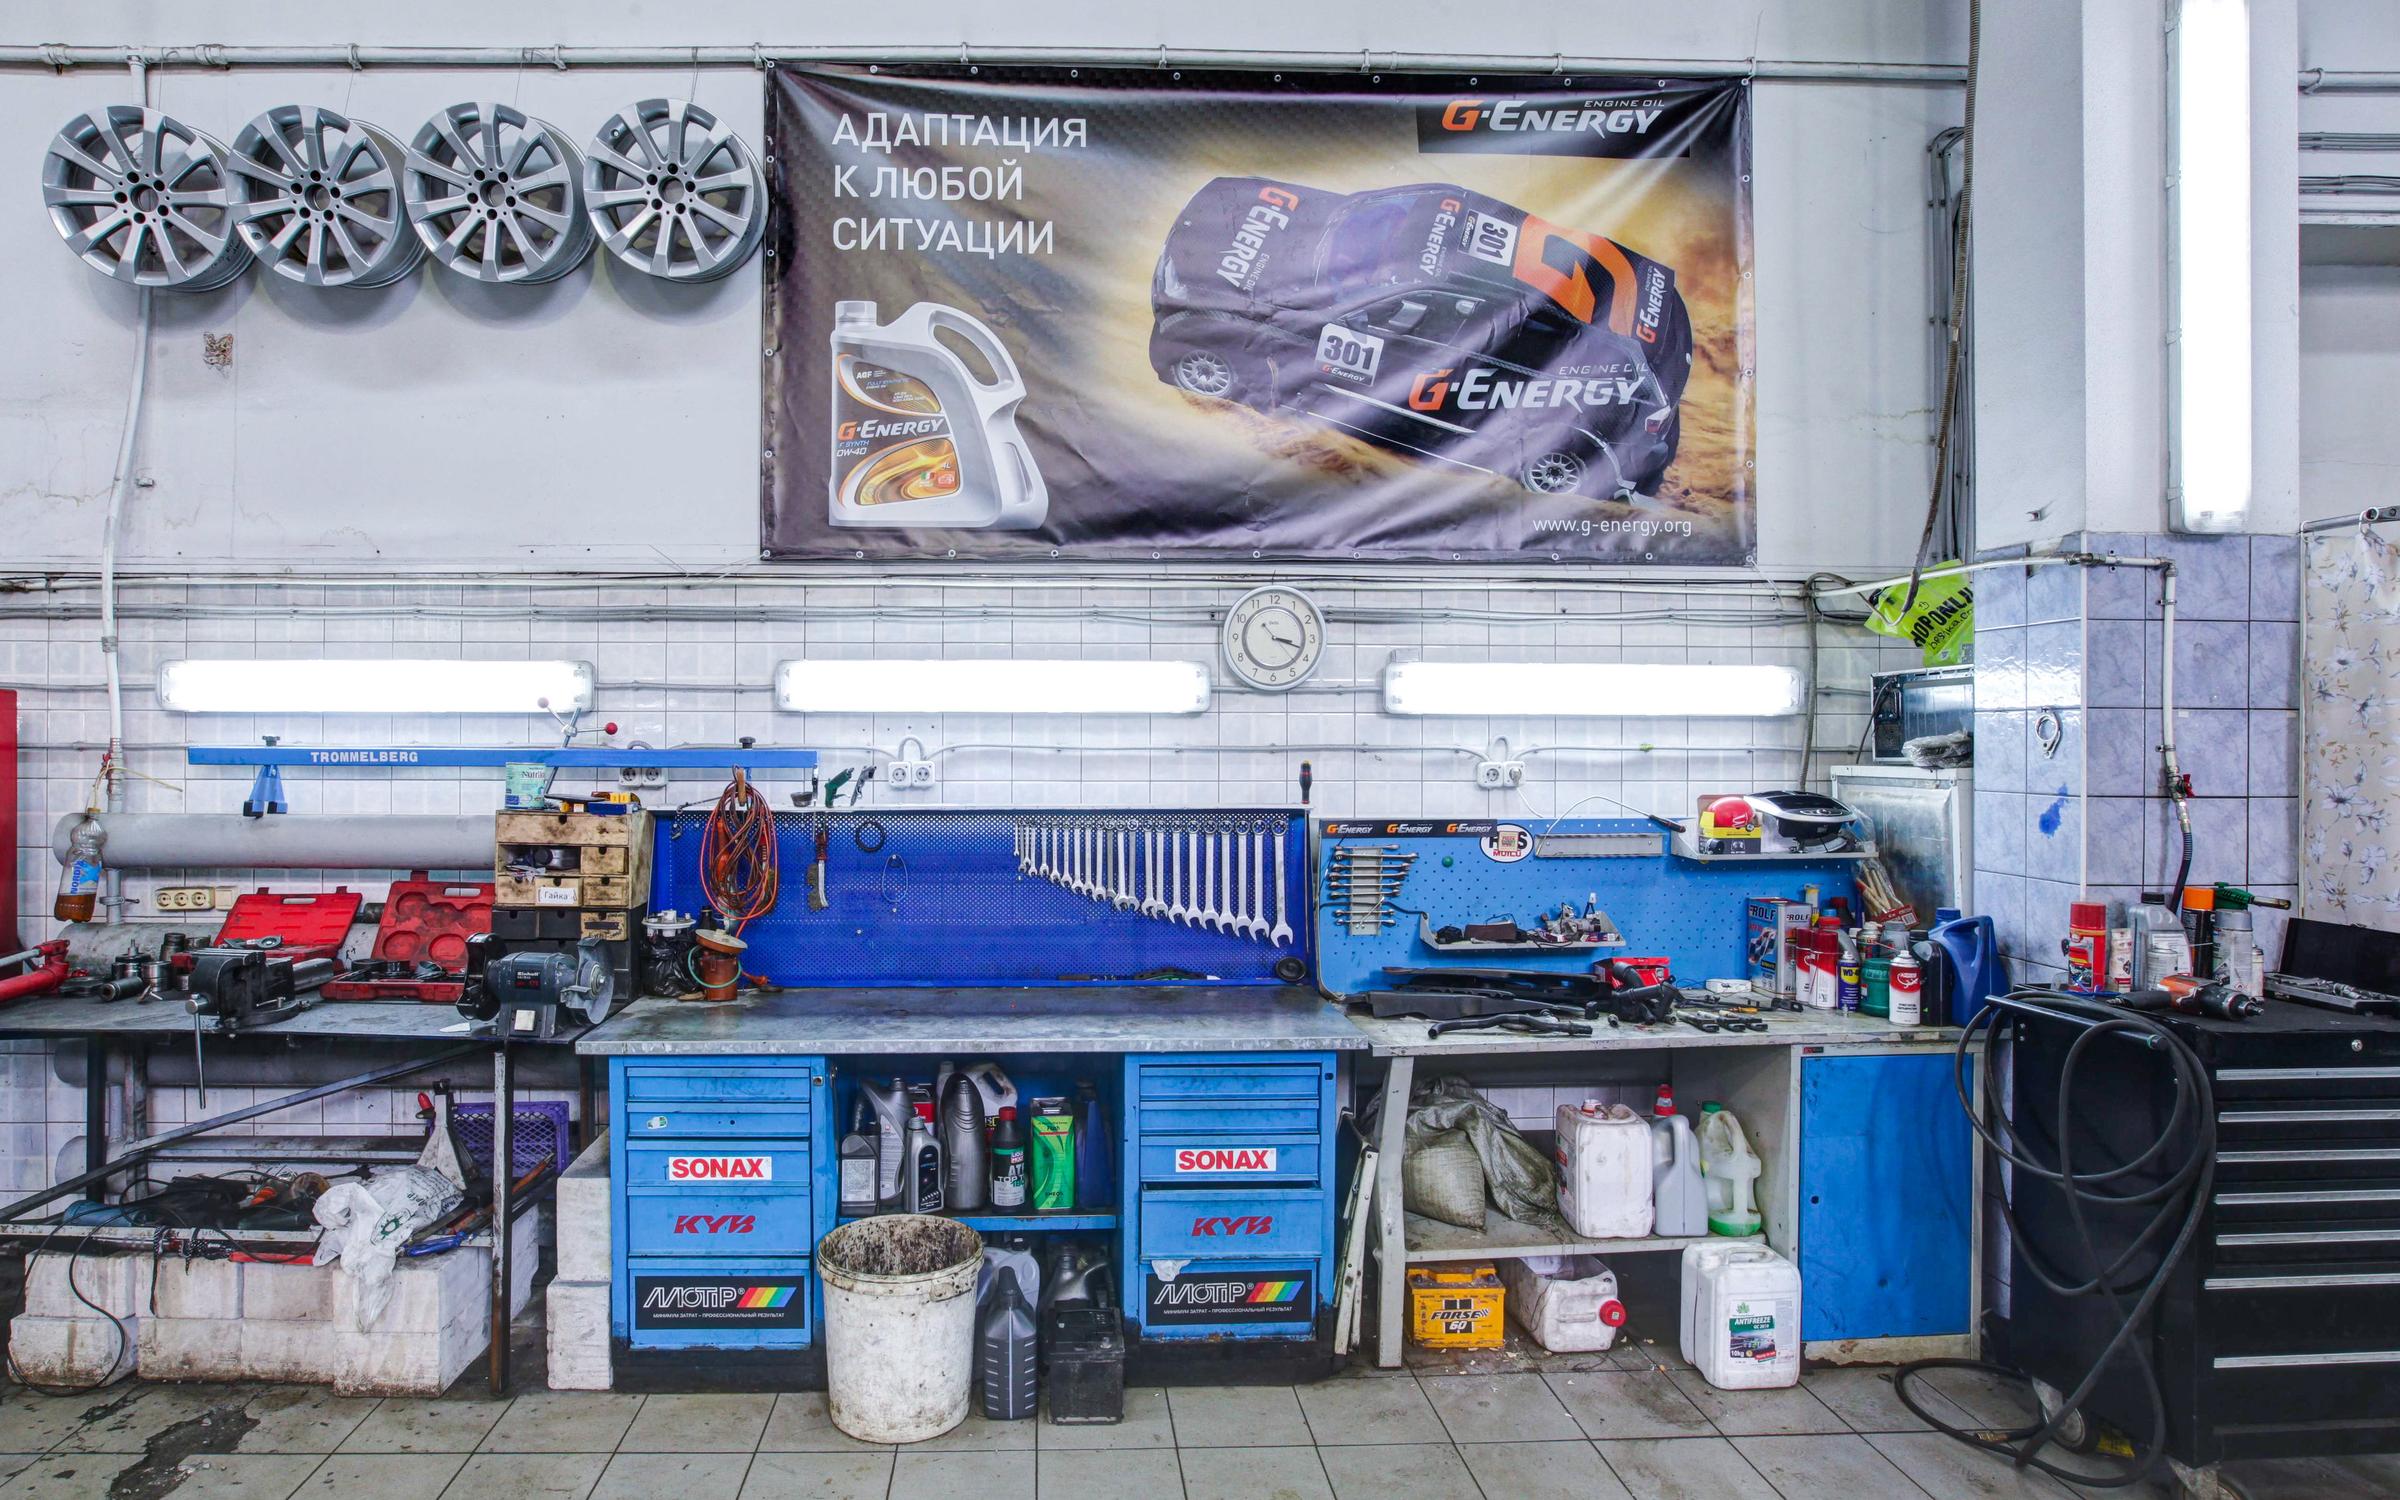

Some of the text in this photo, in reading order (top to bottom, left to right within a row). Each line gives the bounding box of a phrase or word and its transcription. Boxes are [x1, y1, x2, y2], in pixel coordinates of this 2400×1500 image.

[832, 113, 1087, 153] АДАПТАЦИЯ
[834, 159, 1022, 200] К ЛЮБОЙ
[833, 217, 1053, 259] СИТУАЦИИ
[1476, 222, 1509, 258] 301
[1324, 335, 1374, 370] 301
[1533, 519, 1692, 537] www.g-energy.org
[1251, 599, 1260, 609] 11
[1270, 595, 1280, 604] 12
[1291, 601, 1296, 610] 1
[1237, 614, 1246, 623] 10
[1304, 615, 1312, 624] 2
[1232, 633, 1238, 642] 9
[1309, 634, 1315, 643] 3
[1237, 653, 1244, 662] 8
[1303, 654, 1309, 662] 4
[1252, 668, 1258, 677] 7
[1289, 668, 1296, 677] 5
[1270, 673, 1276, 682] 6
[310, 751, 418, 762] TROMMELBERG
[544, 890, 568, 899] Гайка
[1750, 905, 1776, 920] ROLF
[1178, 1150, 1268, 1170] SONAX
[672, 1158, 763, 1179] SONAX
[674, 1215, 756, 1234] KYB
[1191, 1216, 1273, 1236] KYB
[1431, 1311, 1481, 1320] FORSE
[1735, 1316, 1771, 1325] ANTIFREEZE
[1449, 1321, 1467, 1330] 60
